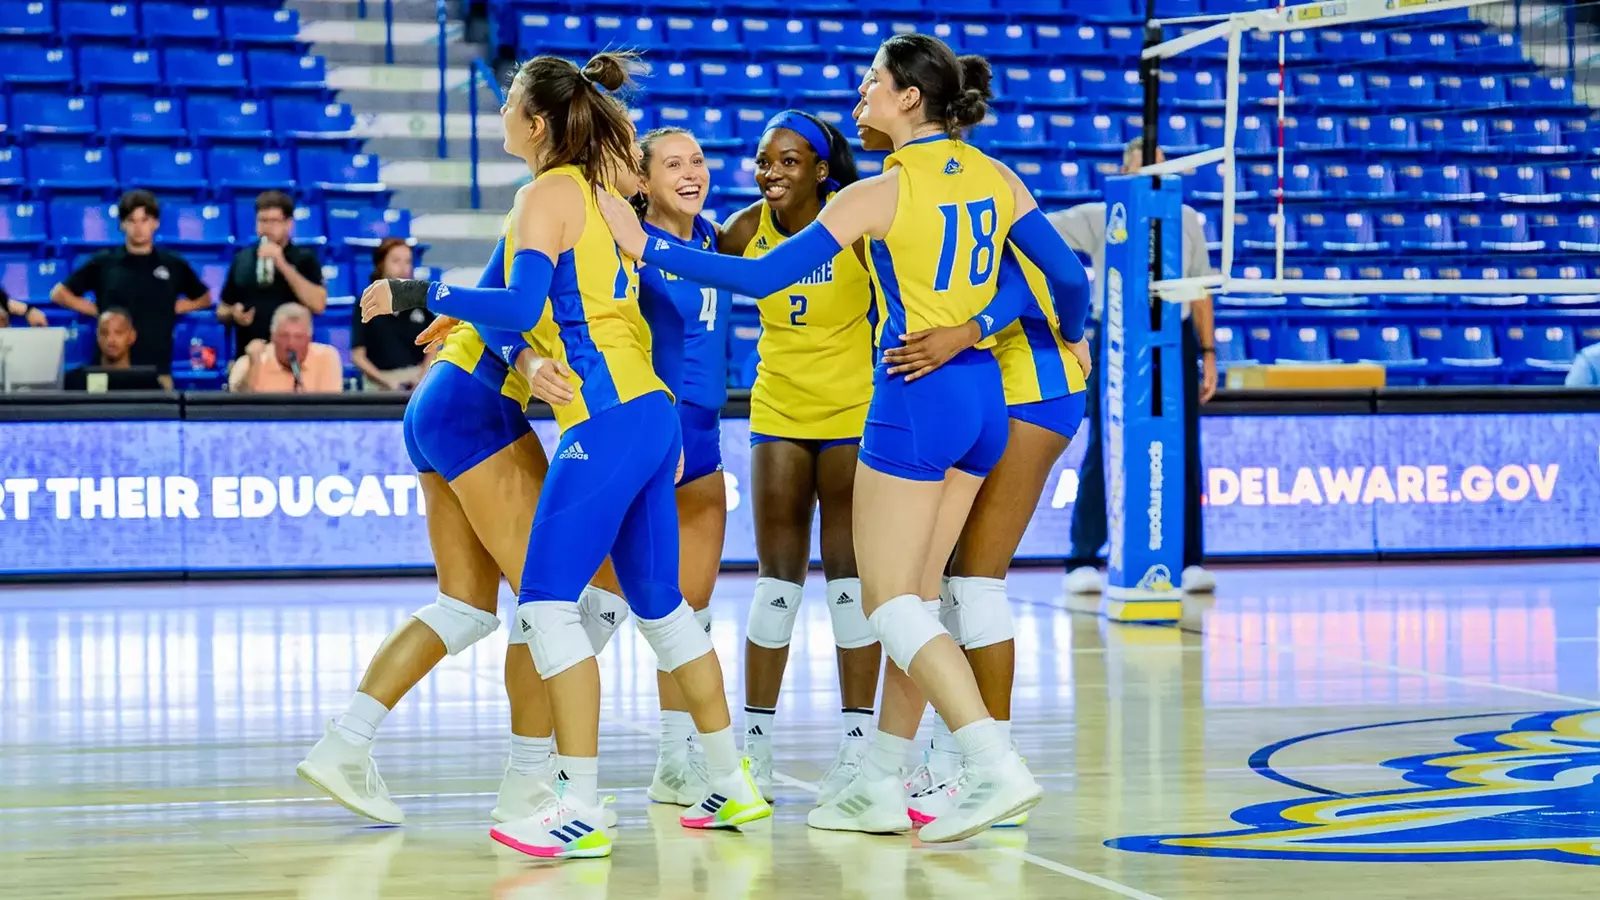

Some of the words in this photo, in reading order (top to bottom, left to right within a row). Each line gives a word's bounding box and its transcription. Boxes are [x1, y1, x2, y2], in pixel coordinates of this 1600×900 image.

[933, 195, 998, 292] 18
[699, 287, 718, 331] 4
[788, 294, 808, 327] 2
[46, 475, 201, 520] THEIR
